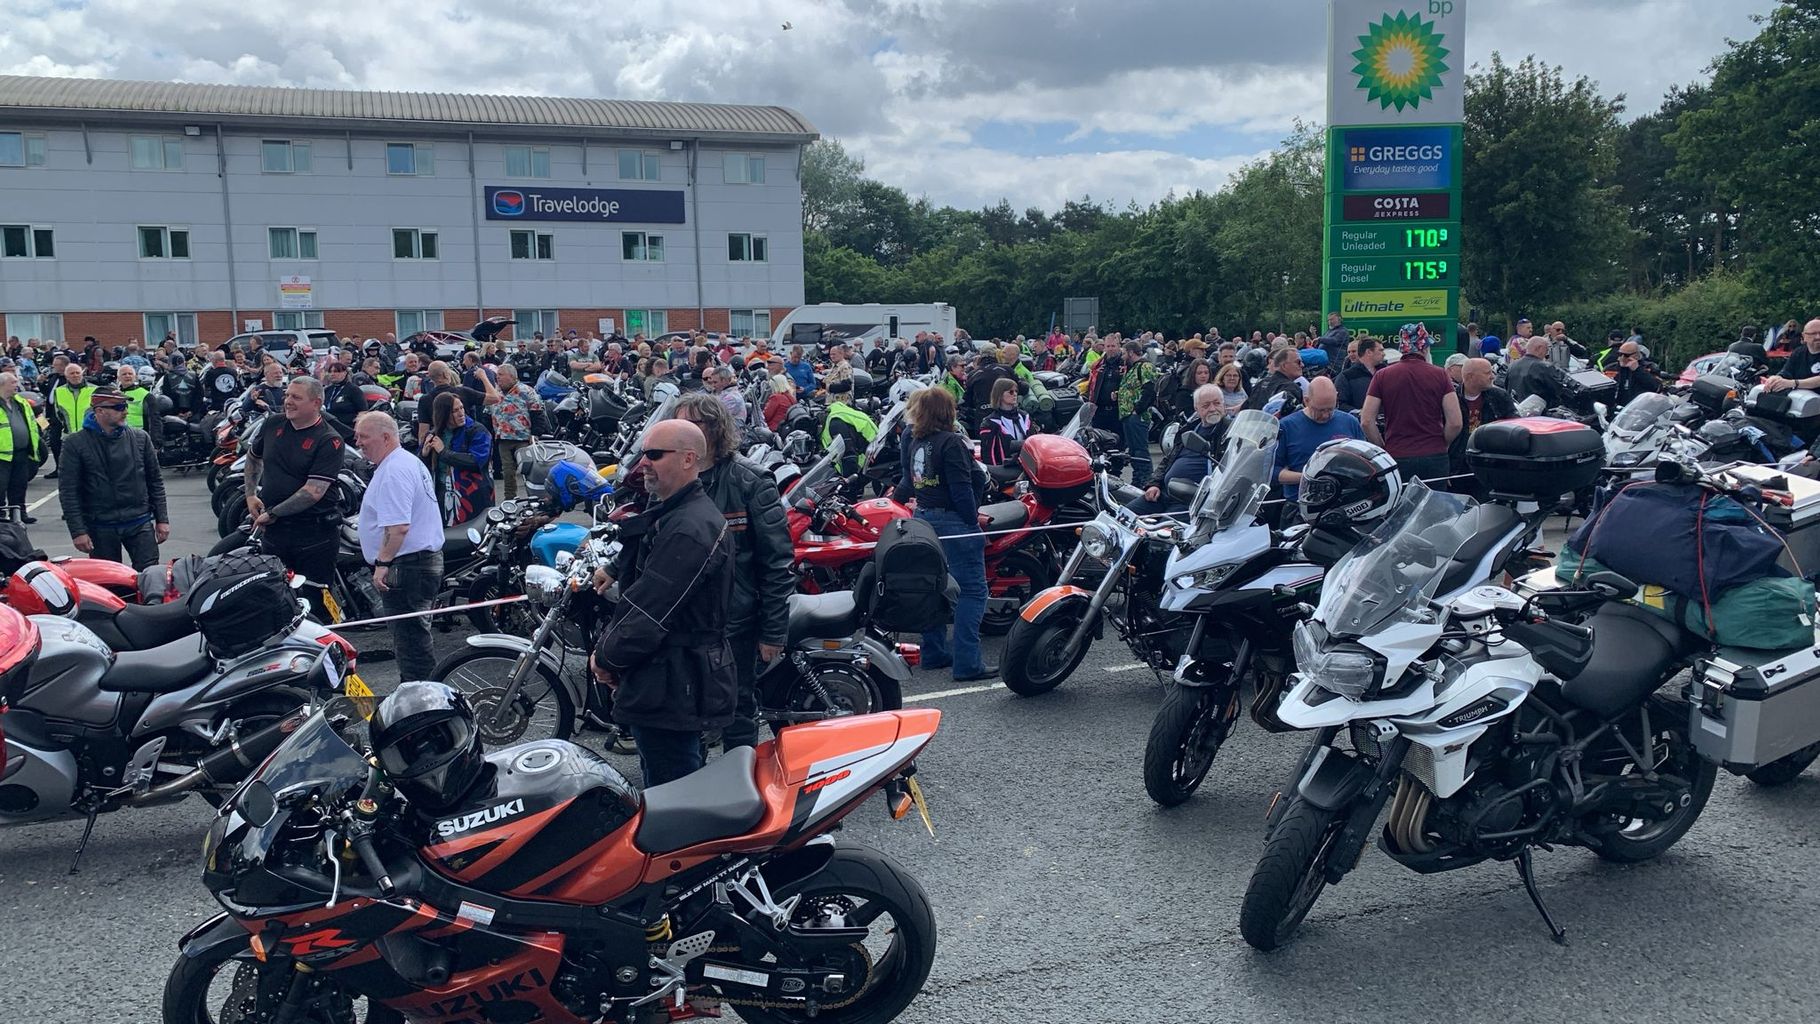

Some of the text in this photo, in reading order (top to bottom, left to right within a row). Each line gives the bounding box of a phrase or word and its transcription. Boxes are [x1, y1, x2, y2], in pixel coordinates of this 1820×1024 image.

[1428, 0, 1453, 17] bp
[1369, 145, 1443, 161] GREGGS
[1353, 163, 1439, 175] Everyday tastes good
[529, 195, 620, 217] Travelodge
[1374, 197, 1420, 209] COSTA
[1381, 210, 1420, 218] EXPRESS
[1342, 231, 1378, 241] Regular
[1342, 242, 1386, 251] Unleaded
[1341, 263, 1377, 274] Regular
[1341, 275, 1369, 283] Diesel
[1344, 301, 1404, 312] ultimate
[1346, 502, 1369, 515] SHOEI
[1454, 705, 1489, 723] TRIUMPH
[803, 769, 851, 794] 1000
[437, 798, 525, 837] SUZUKI
[679, 890, 694, 901] ISLE
[703, 876, 719, 887] MAN
